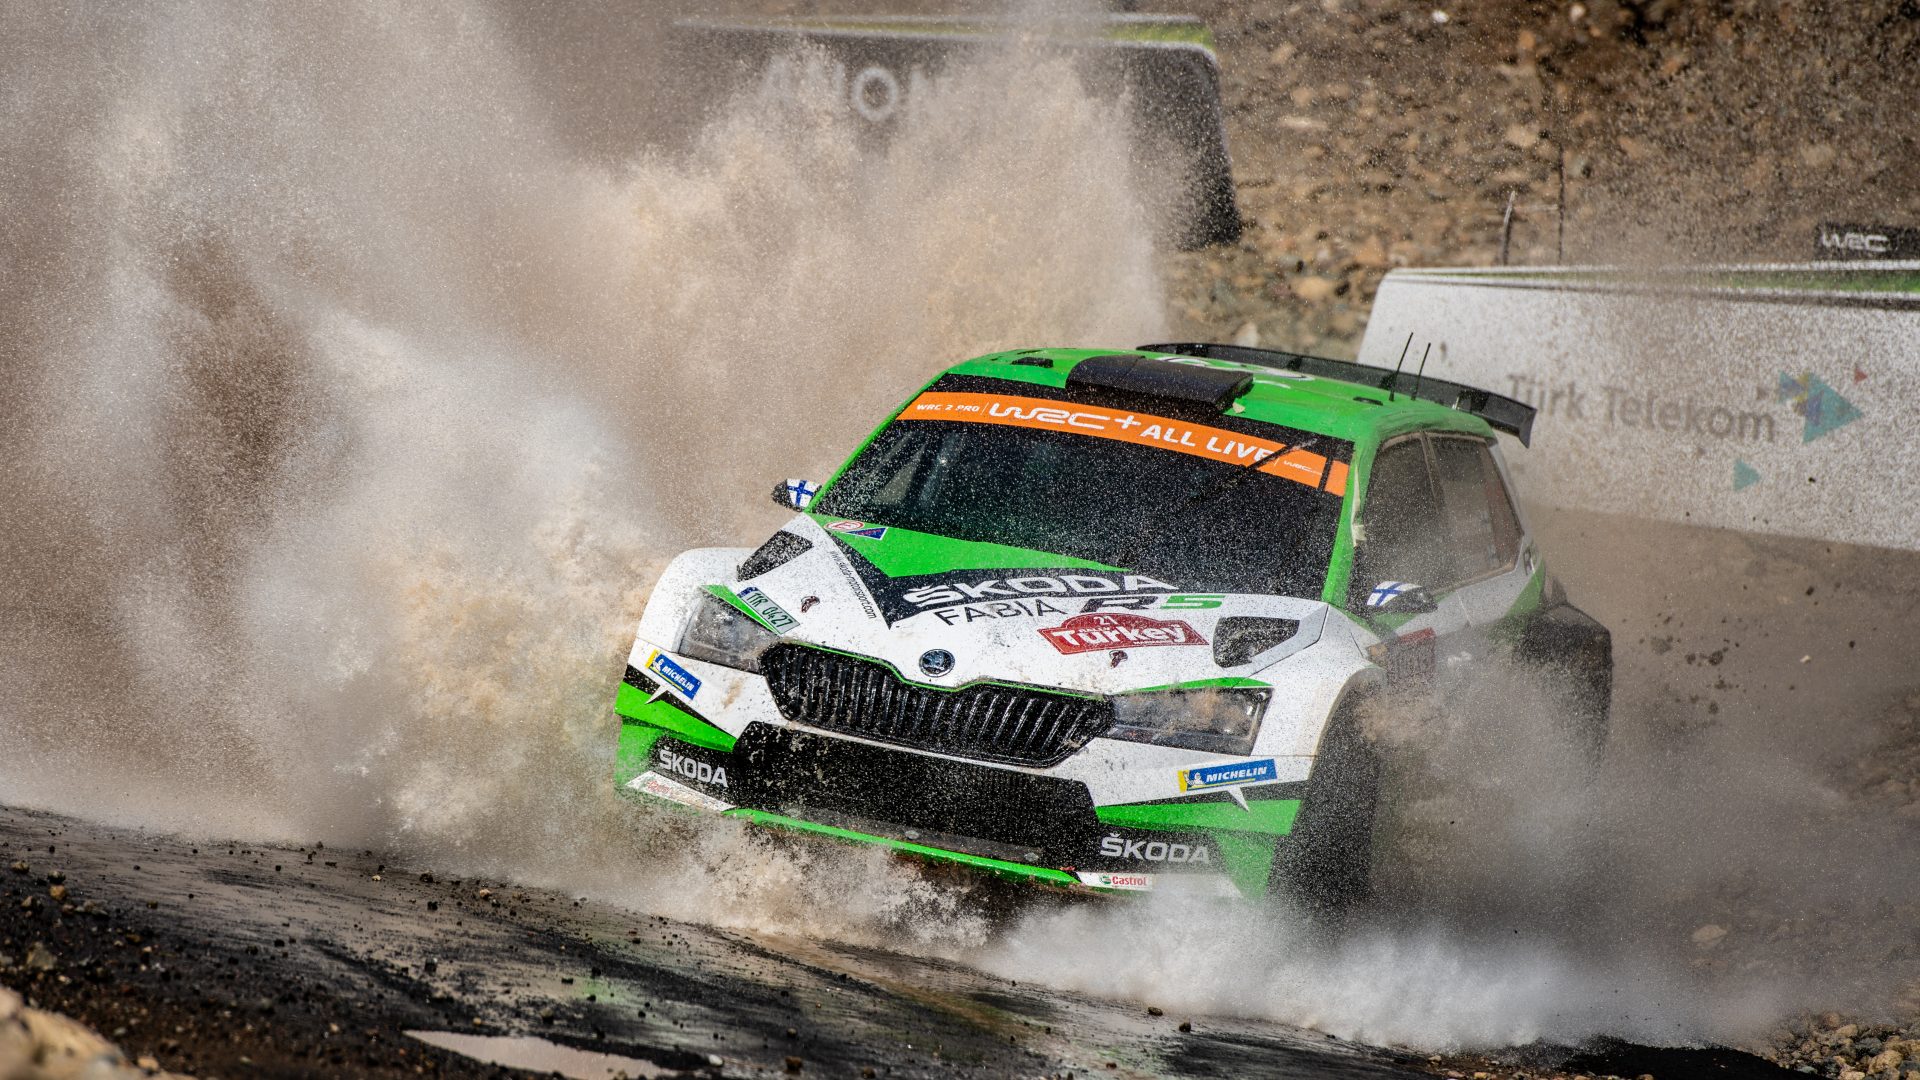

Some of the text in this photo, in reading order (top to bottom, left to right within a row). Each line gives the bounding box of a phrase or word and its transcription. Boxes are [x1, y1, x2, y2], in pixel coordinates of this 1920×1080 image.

[916, 403, 943, 412] WRC
[956, 405, 980, 413] PRO
[1140, 424, 1197, 447] ALL
[1205, 436, 1276, 462] LIVE
[902, 574, 1179, 606] ŠKODA
[933, 594, 1227, 626] FABIA R5
[662, 663, 695, 692] MICHELIN
[658, 746, 729, 788] ŠKODA
[1205, 766, 1268, 783] MICHELIN
[1100, 831, 1210, 863] ŠKODA
[1111, 875, 1147, 886] Castrol
